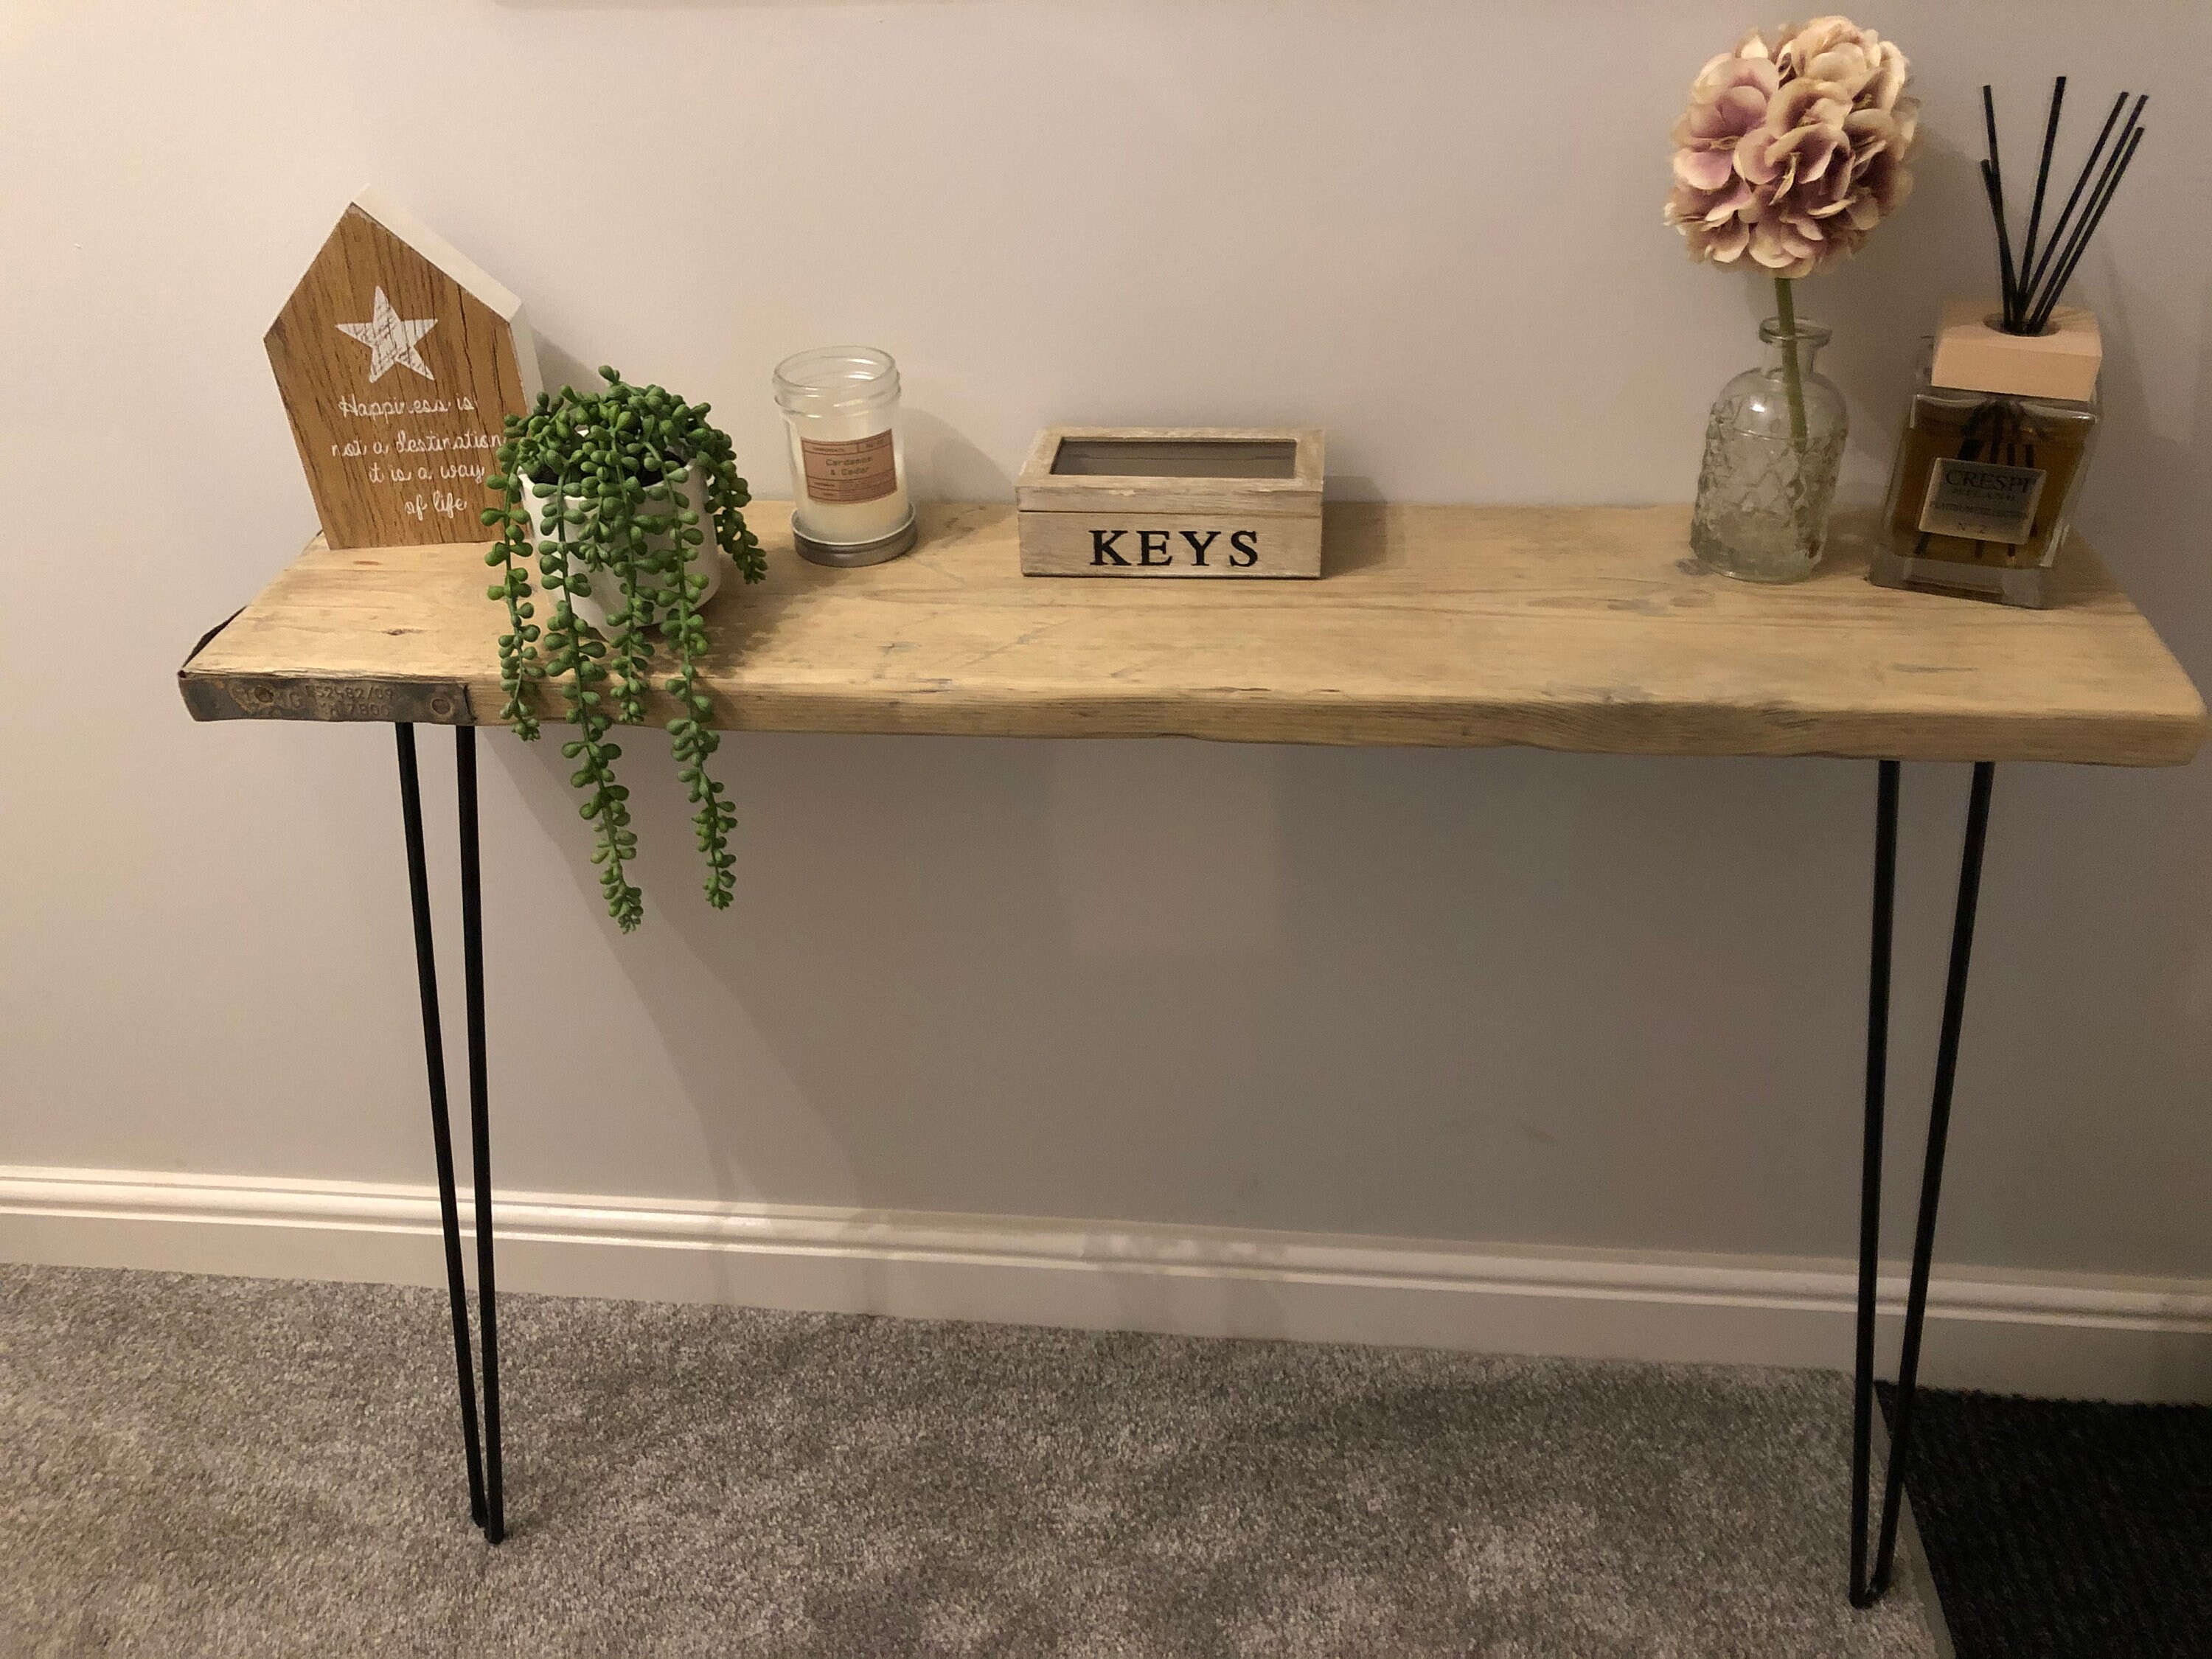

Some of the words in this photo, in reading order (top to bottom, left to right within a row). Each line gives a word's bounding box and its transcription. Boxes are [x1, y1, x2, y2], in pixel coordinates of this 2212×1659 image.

[338, 393, 452, 425] Happiness
[456, 393, 479, 411] is
[331, 440, 367, 457] not
[372, 442, 390, 455] a
[395, 430, 505, 453] destination
[368, 462, 385, 484] it
[391, 465, 412, 481] is
[417, 467, 432, 480] a
[439, 465, 485, 484] way
[405, 493, 428, 521] of
[433, 490, 468, 519] life
[1089, 529, 1259, 567] KEYS
